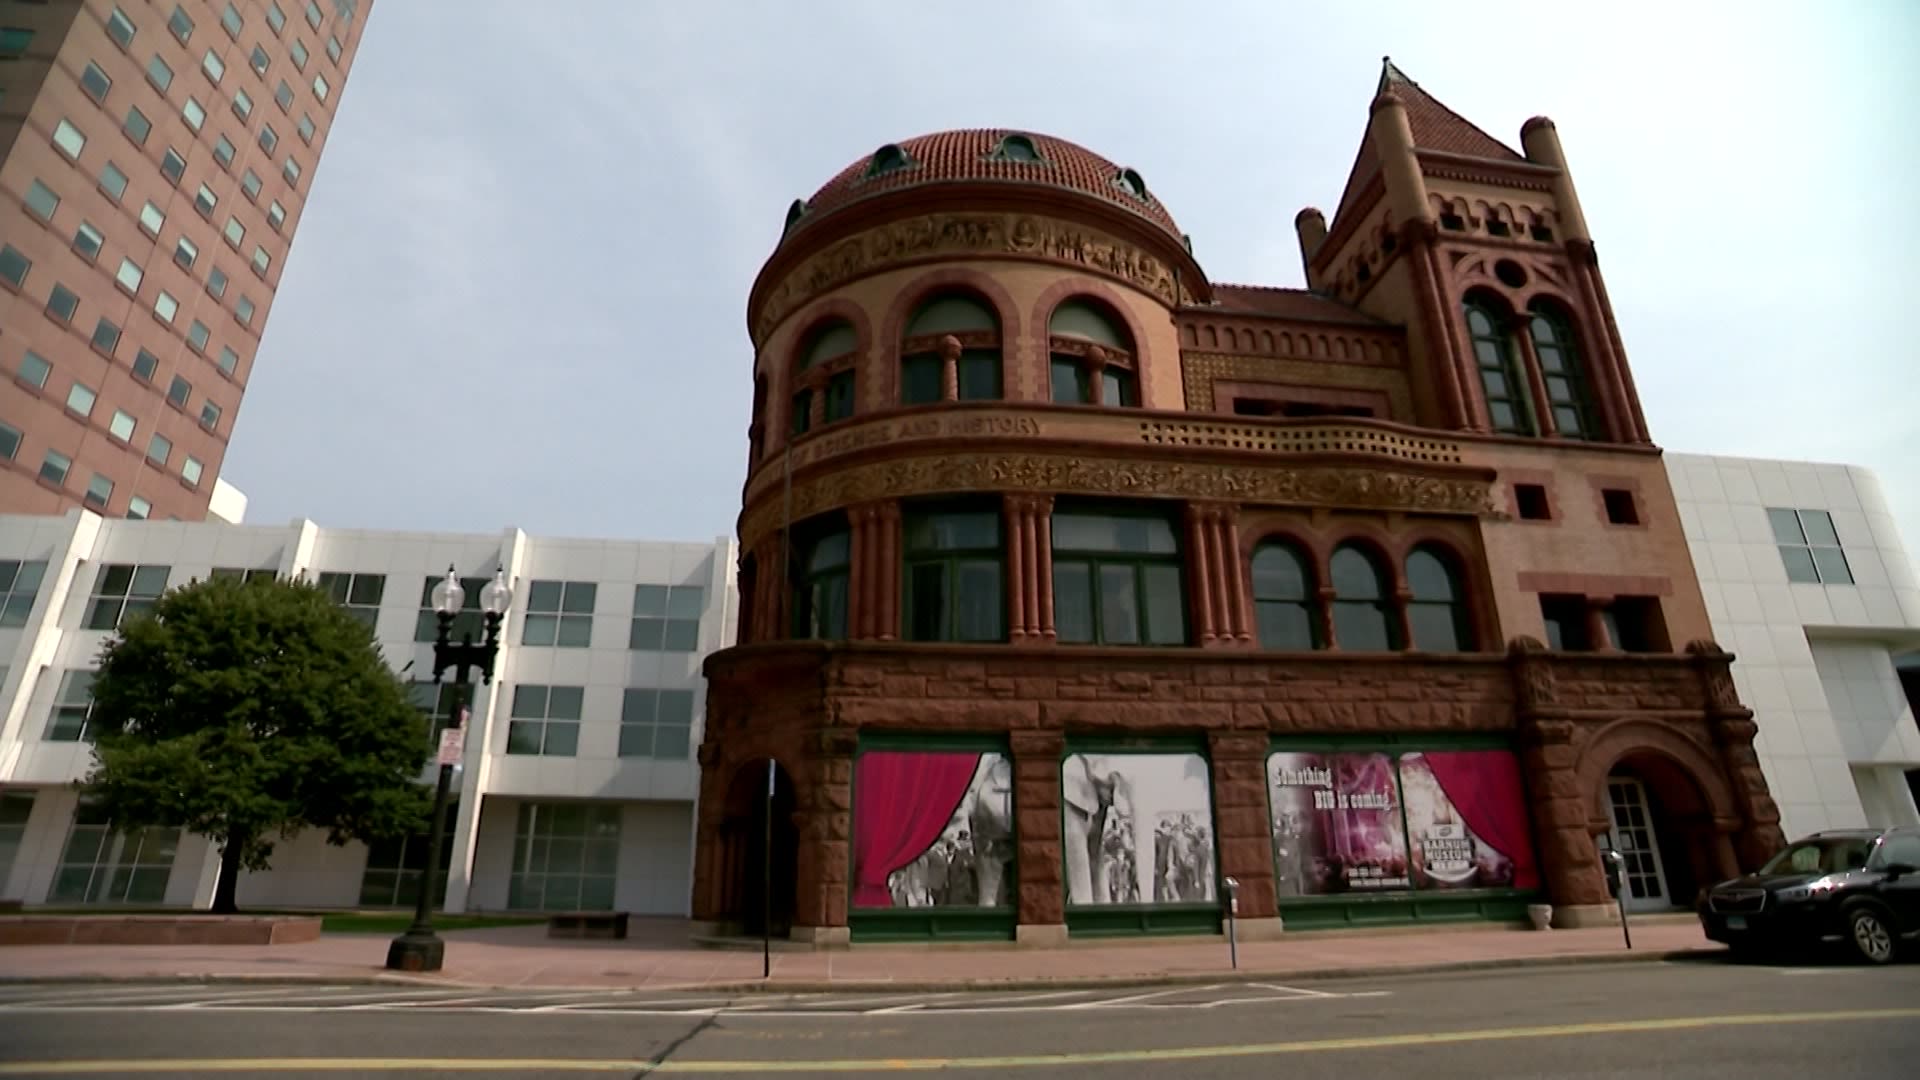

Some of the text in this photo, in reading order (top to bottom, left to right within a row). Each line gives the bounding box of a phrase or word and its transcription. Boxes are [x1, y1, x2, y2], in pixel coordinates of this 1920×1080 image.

[896, 418, 938, 438] AND
[947, 415, 1041, 434] HISTORY
[1275, 766, 1332, 789] Something
[1314, 790, 1335, 809] BIG
[1337, 790, 1348, 809] is
[1423, 839, 1470, 849] BARNUM
[1424, 849, 1472, 860] MUSEUM
